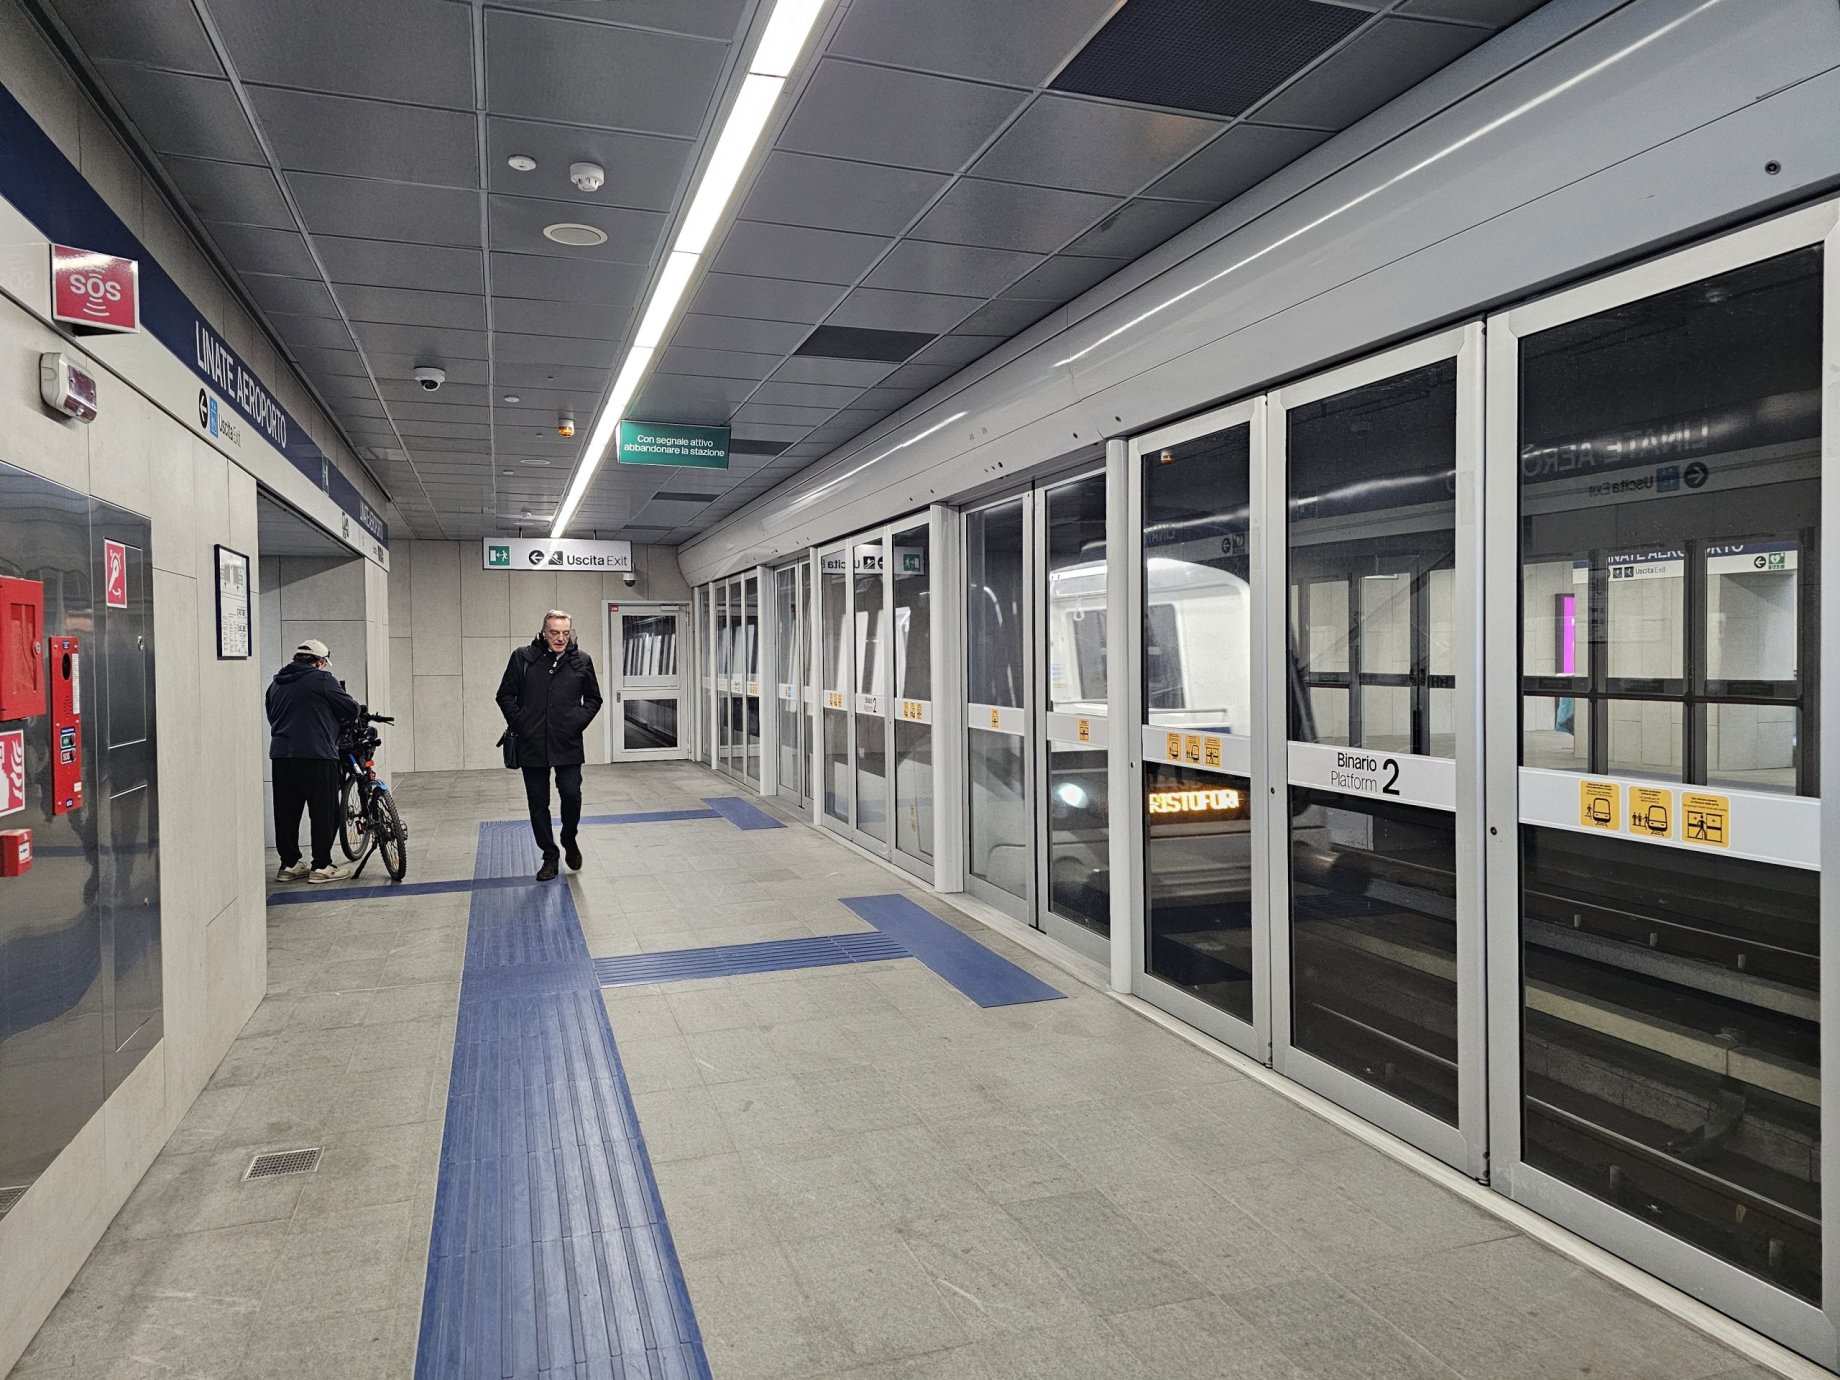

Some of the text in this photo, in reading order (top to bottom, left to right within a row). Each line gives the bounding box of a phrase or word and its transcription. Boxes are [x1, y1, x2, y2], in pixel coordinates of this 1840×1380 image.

[69, 273, 121, 301] SOS
[195, 320, 287, 449] LINATE AEROPORTO
[623, 443, 725, 457] abbandonare la stazione
[637, 434, 714, 448] Con segnale attivo
[567, 555, 628, 567] Uscita Exit
[1635, 567, 1654, 575] Uscita
[1331, 770, 1377, 793] Platform
[1337, 752, 1400, 796] Binario 2
